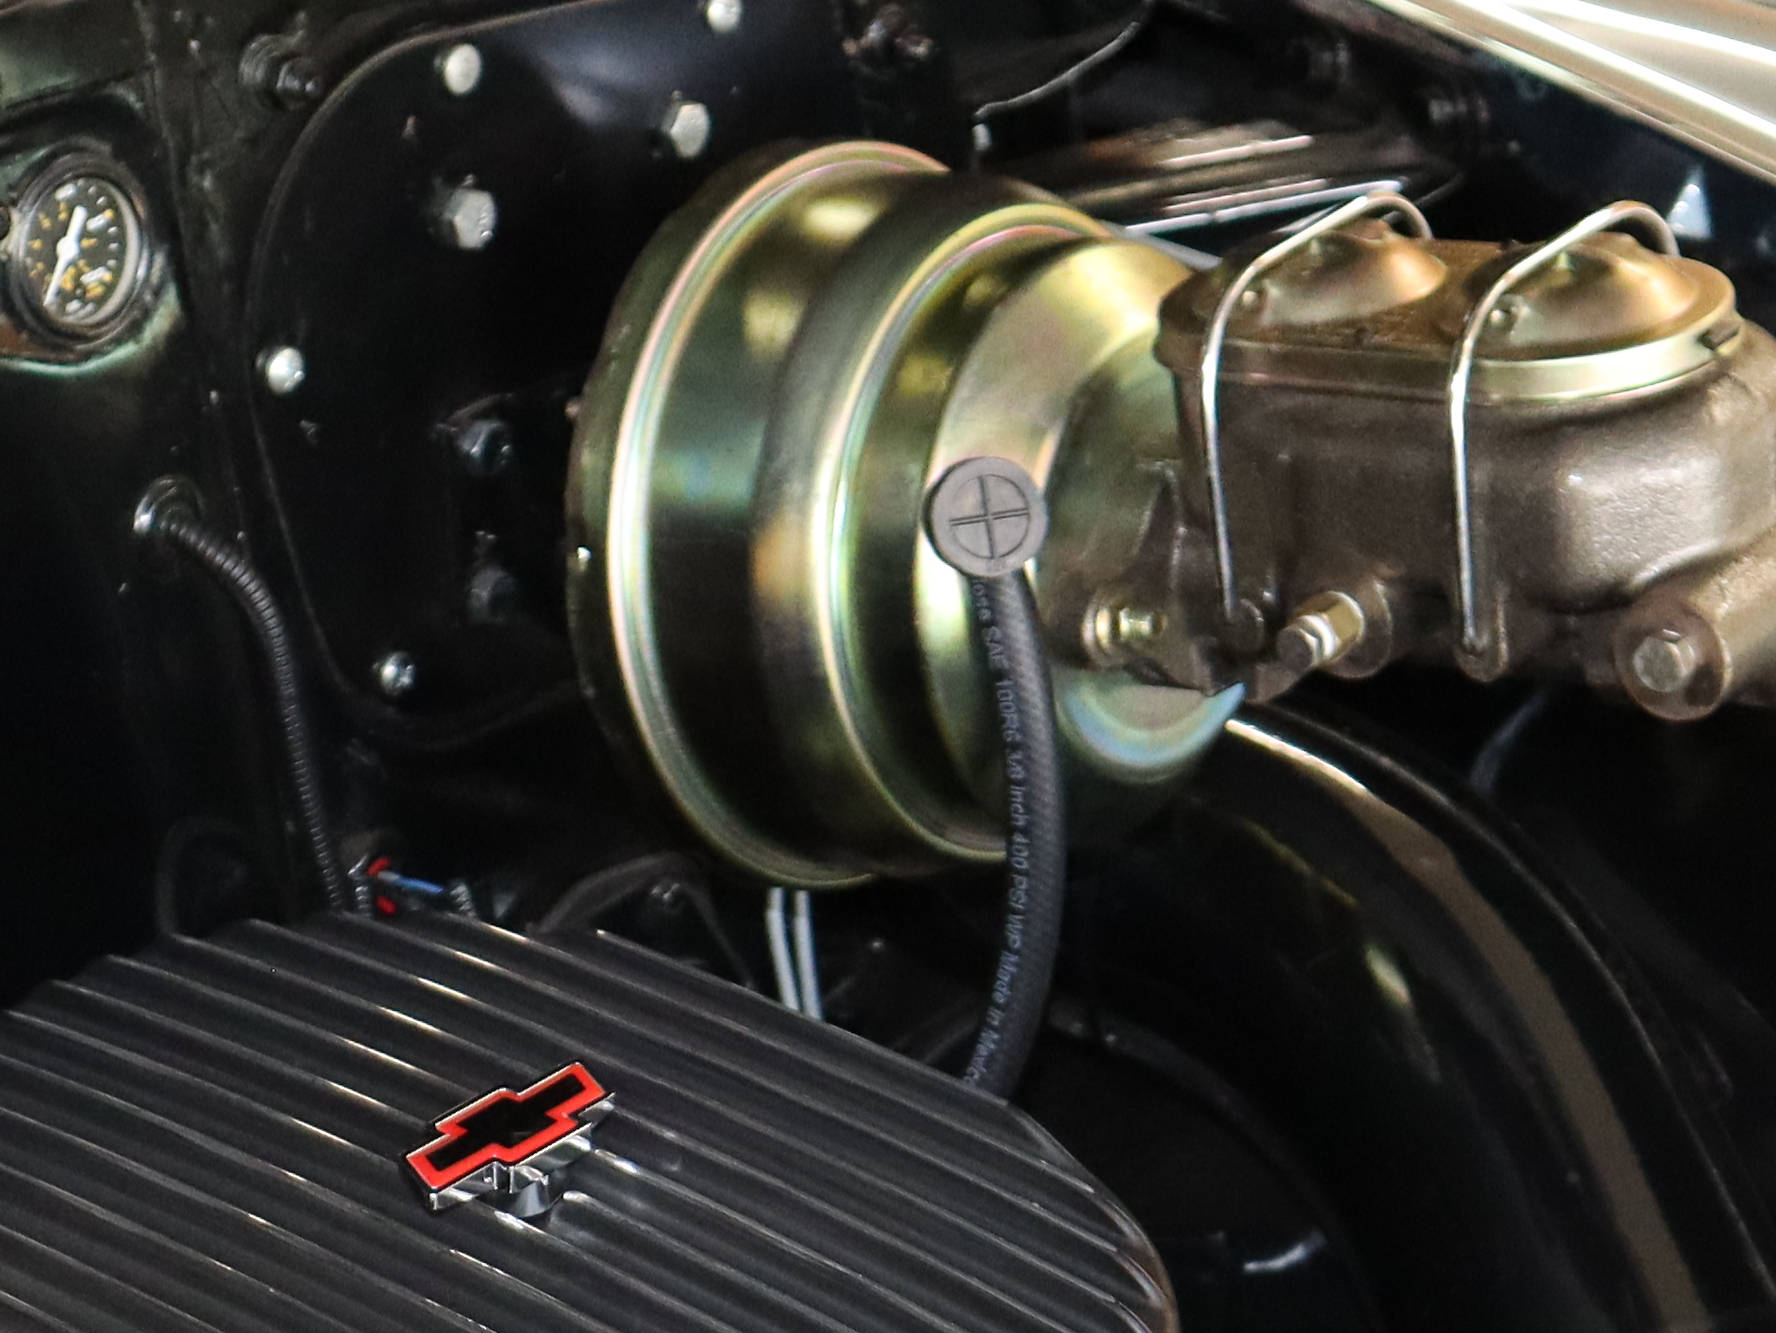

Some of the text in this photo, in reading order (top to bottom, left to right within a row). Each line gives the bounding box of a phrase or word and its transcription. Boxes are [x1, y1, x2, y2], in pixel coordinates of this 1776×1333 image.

[1010, 785, 1030, 826] inch
[1011, 832, 1029, 868] 400
[1011, 874, 1028, 910] PSI
[992, 952, 1018, 1004] Made
[986, 1007, 1004, 1027] in
